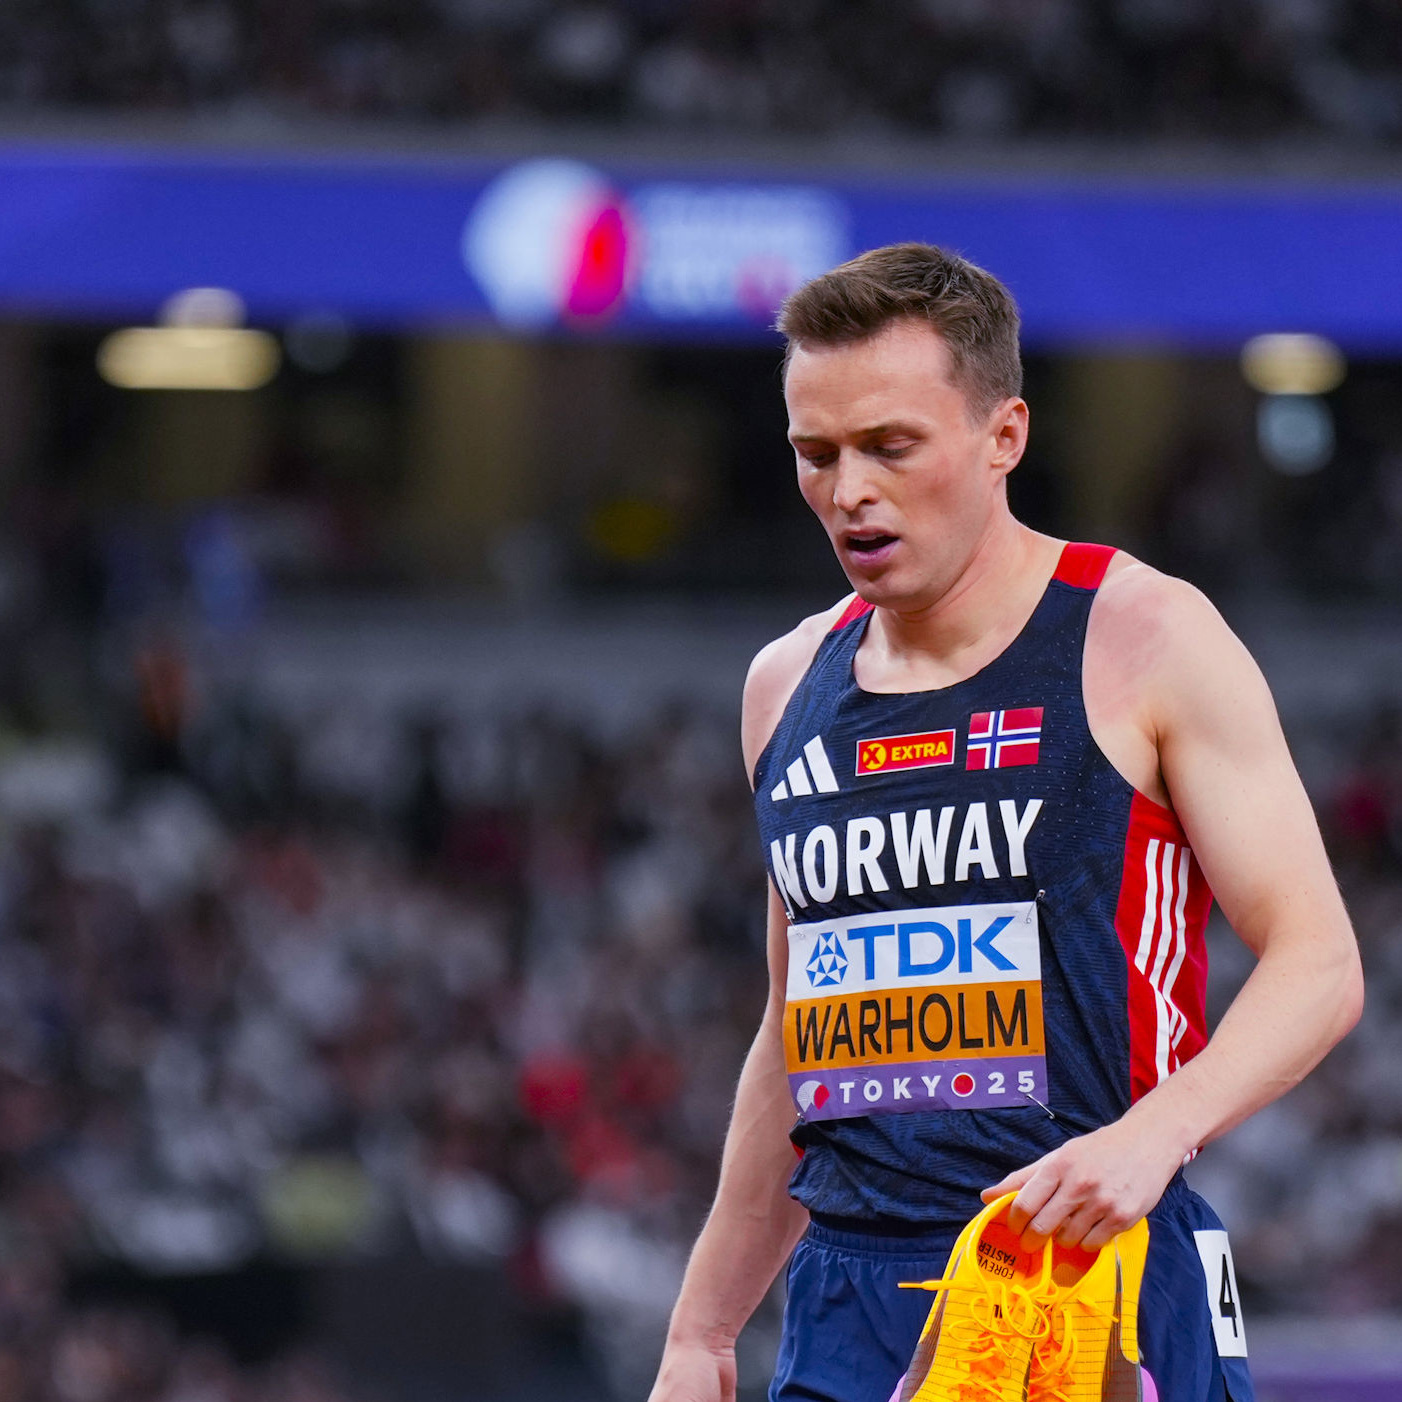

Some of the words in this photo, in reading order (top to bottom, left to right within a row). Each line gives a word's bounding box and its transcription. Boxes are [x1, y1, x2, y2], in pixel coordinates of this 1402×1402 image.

[891, 741, 948, 761] EXTRA
[770, 799, 1044, 917] NORWAY
[847, 916, 1019, 980] TDK
[796, 989, 1028, 1062] WARHOLM
[978, 1239, 1017, 1267] FASTER
[1219, 1253, 1238, 1338] 4
